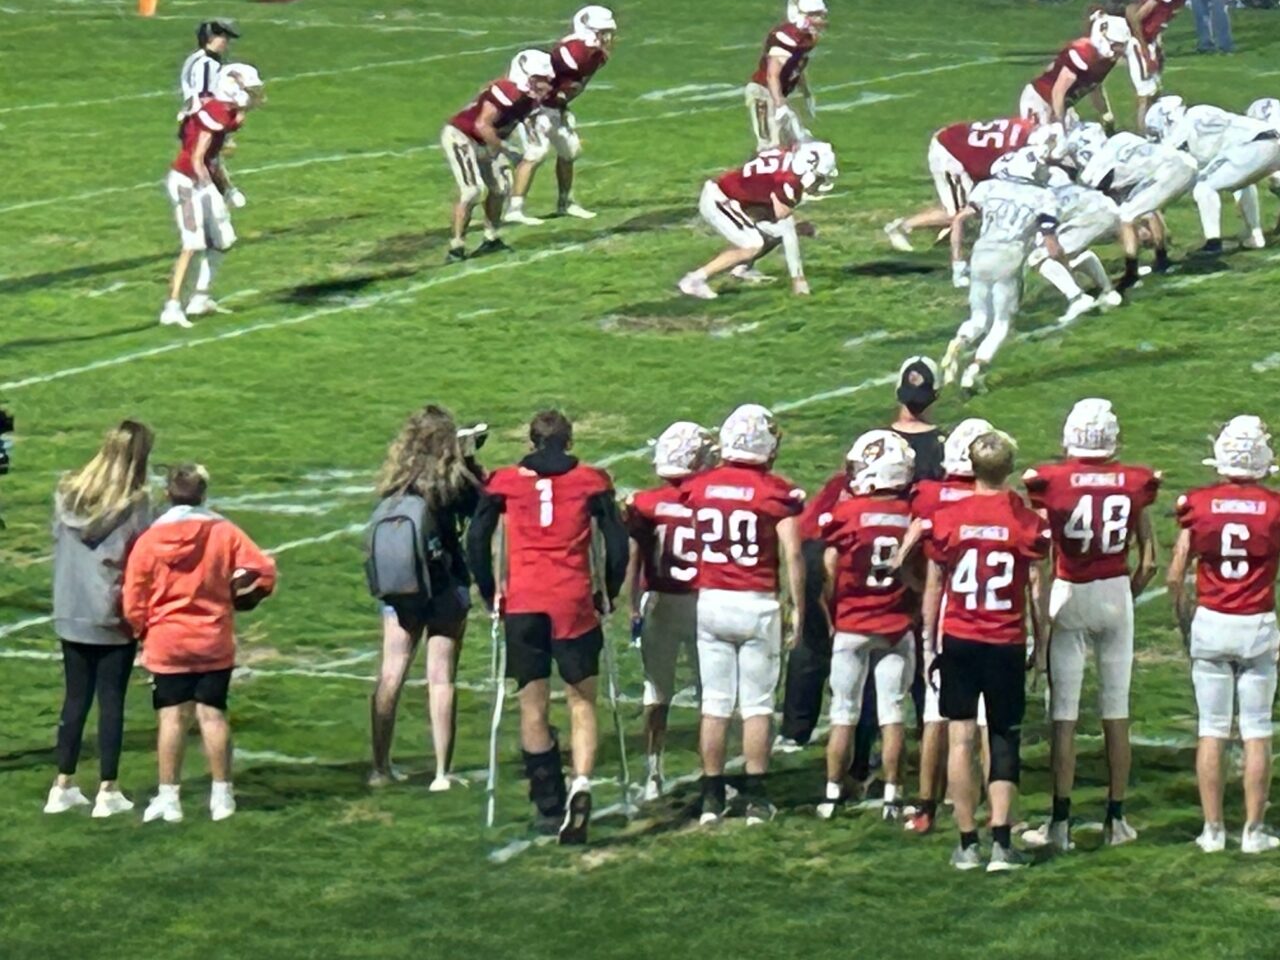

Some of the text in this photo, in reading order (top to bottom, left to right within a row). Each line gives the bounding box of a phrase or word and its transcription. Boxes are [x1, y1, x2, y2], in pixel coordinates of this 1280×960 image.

[535, 478, 553, 527] 1
[1064, 494, 1131, 554] 48
[696, 507, 760, 567] 20
[1220, 523, 1250, 579] 6
[951, 547, 1014, 611] 42
